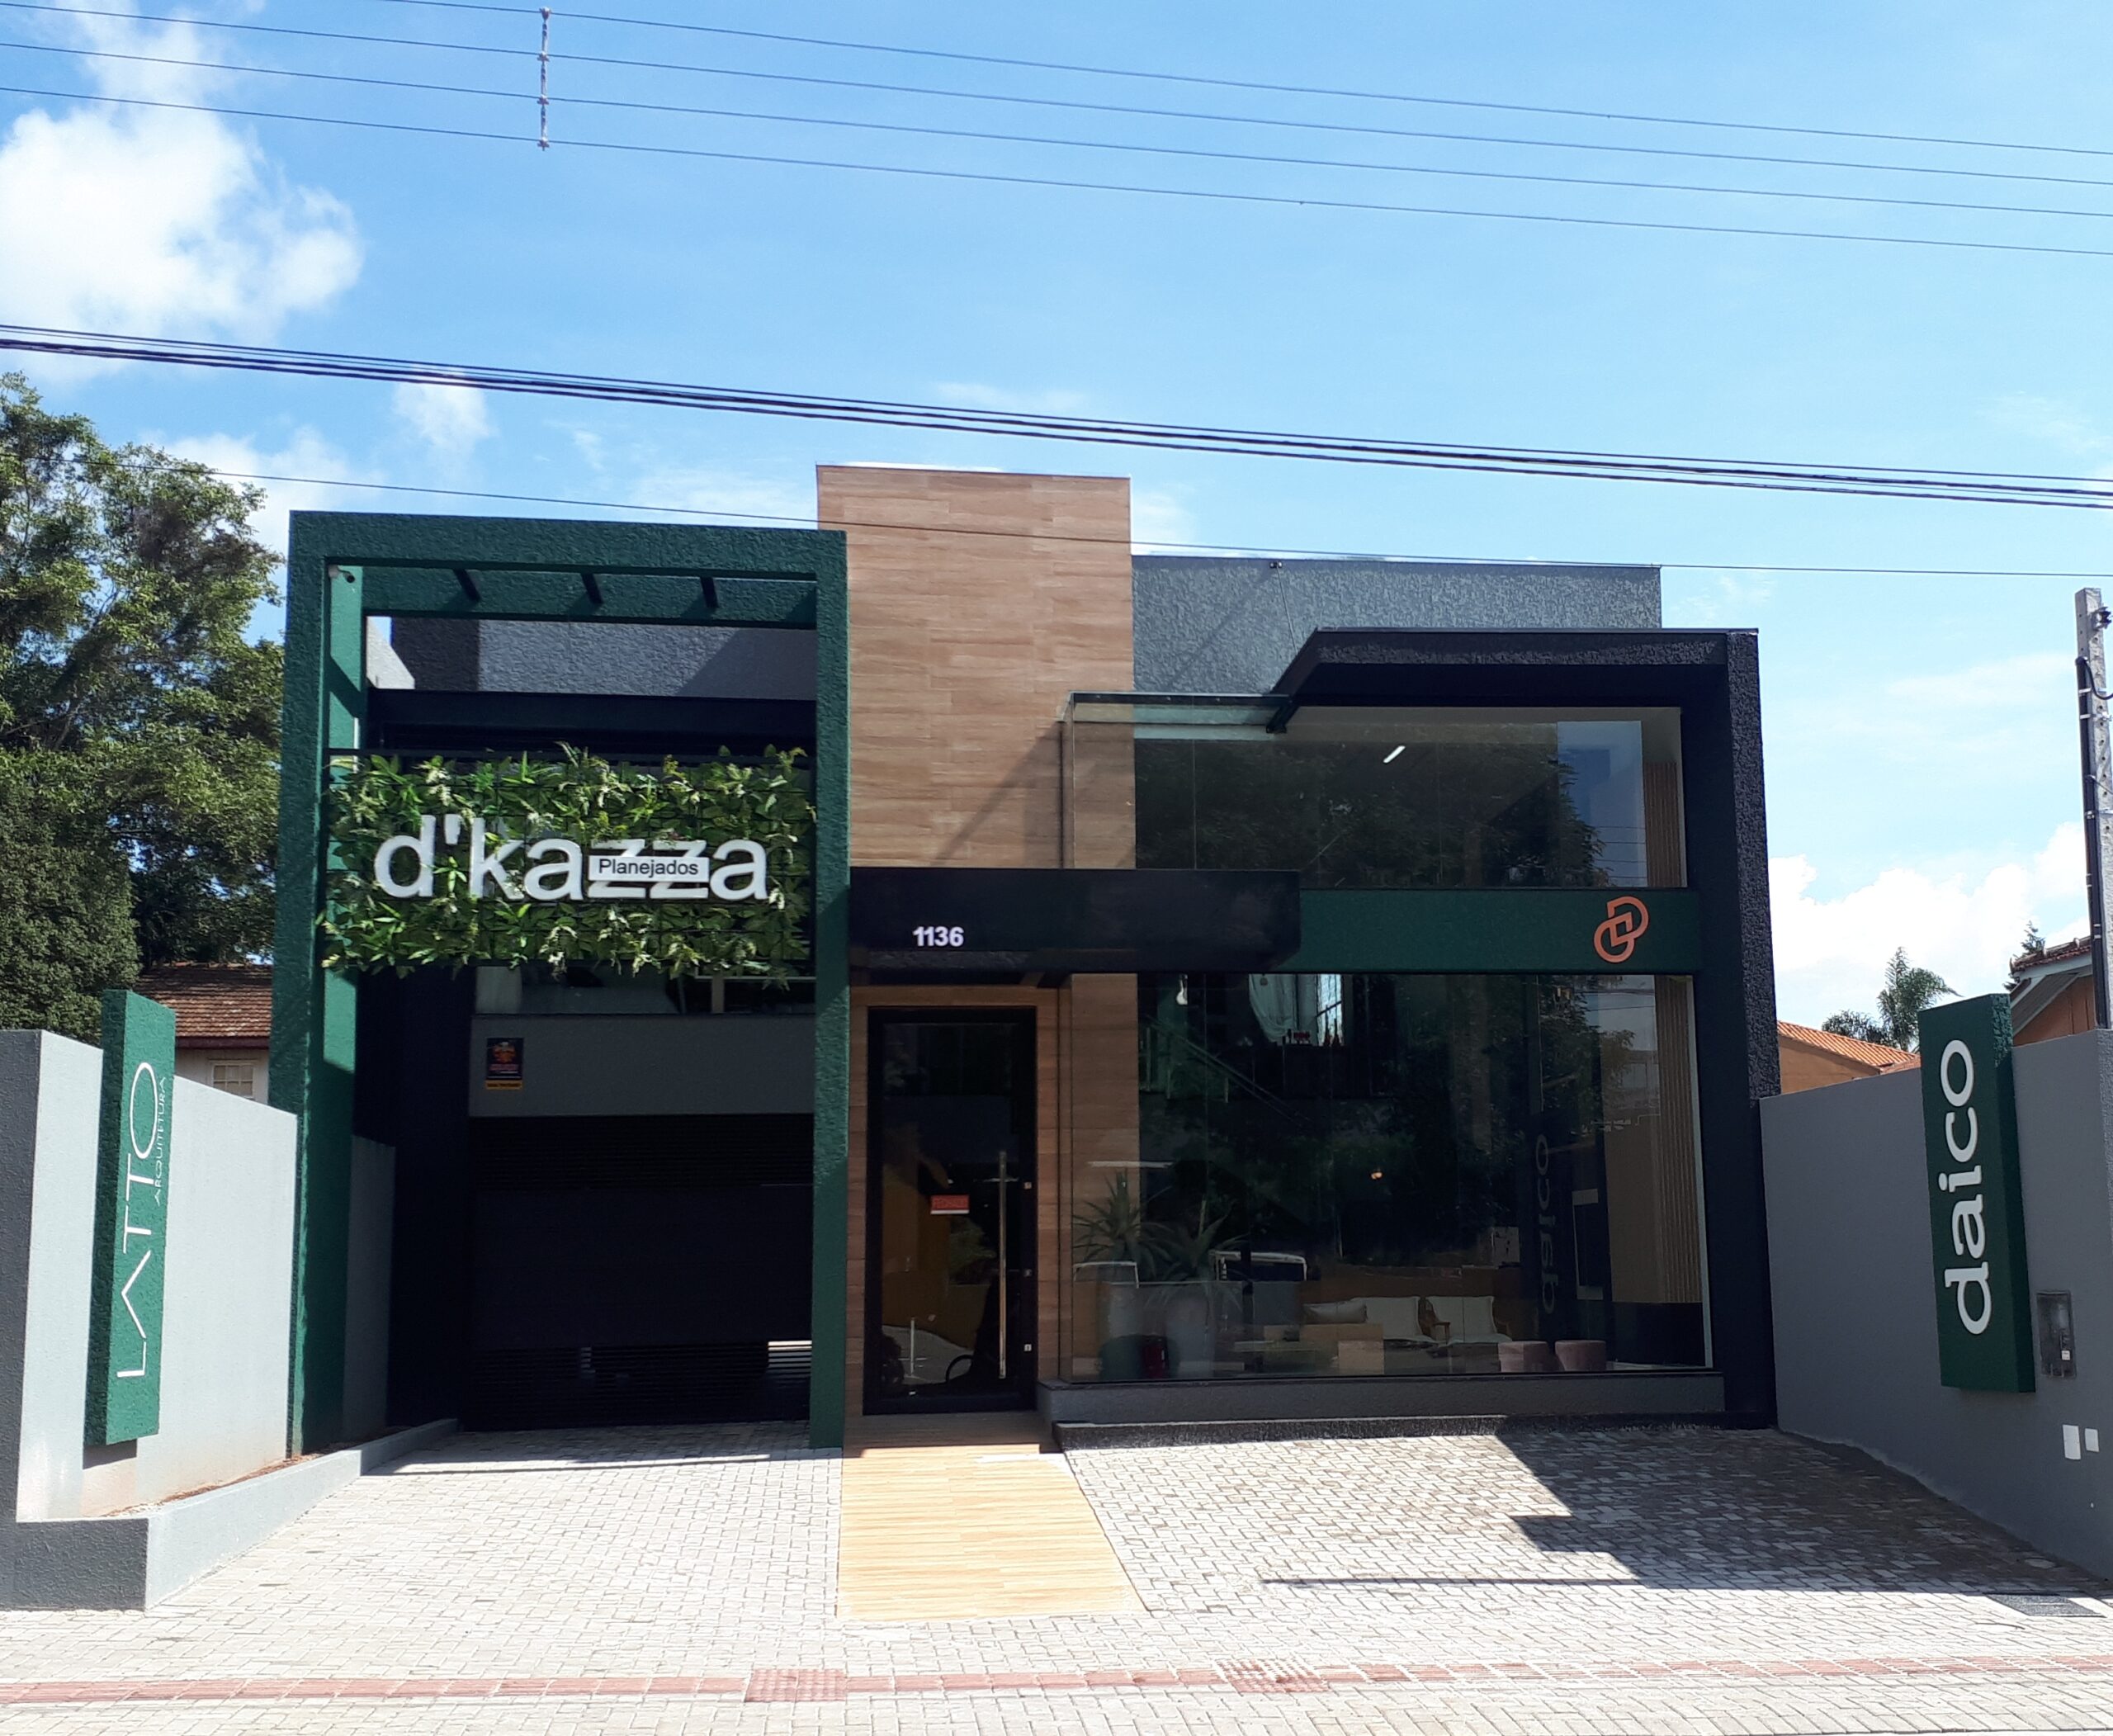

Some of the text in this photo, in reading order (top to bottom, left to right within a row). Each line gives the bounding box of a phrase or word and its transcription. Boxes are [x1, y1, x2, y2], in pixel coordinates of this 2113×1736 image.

[373, 814, 769, 901] d'kazza
[598, 859, 699, 878] Planejados
[912, 925, 964, 947] 1136
[154, 1076, 167, 1208] ARQUITETURA
[1938, 1038, 1992, 1336] daico
[117, 1062, 159, 1378] LATTO
